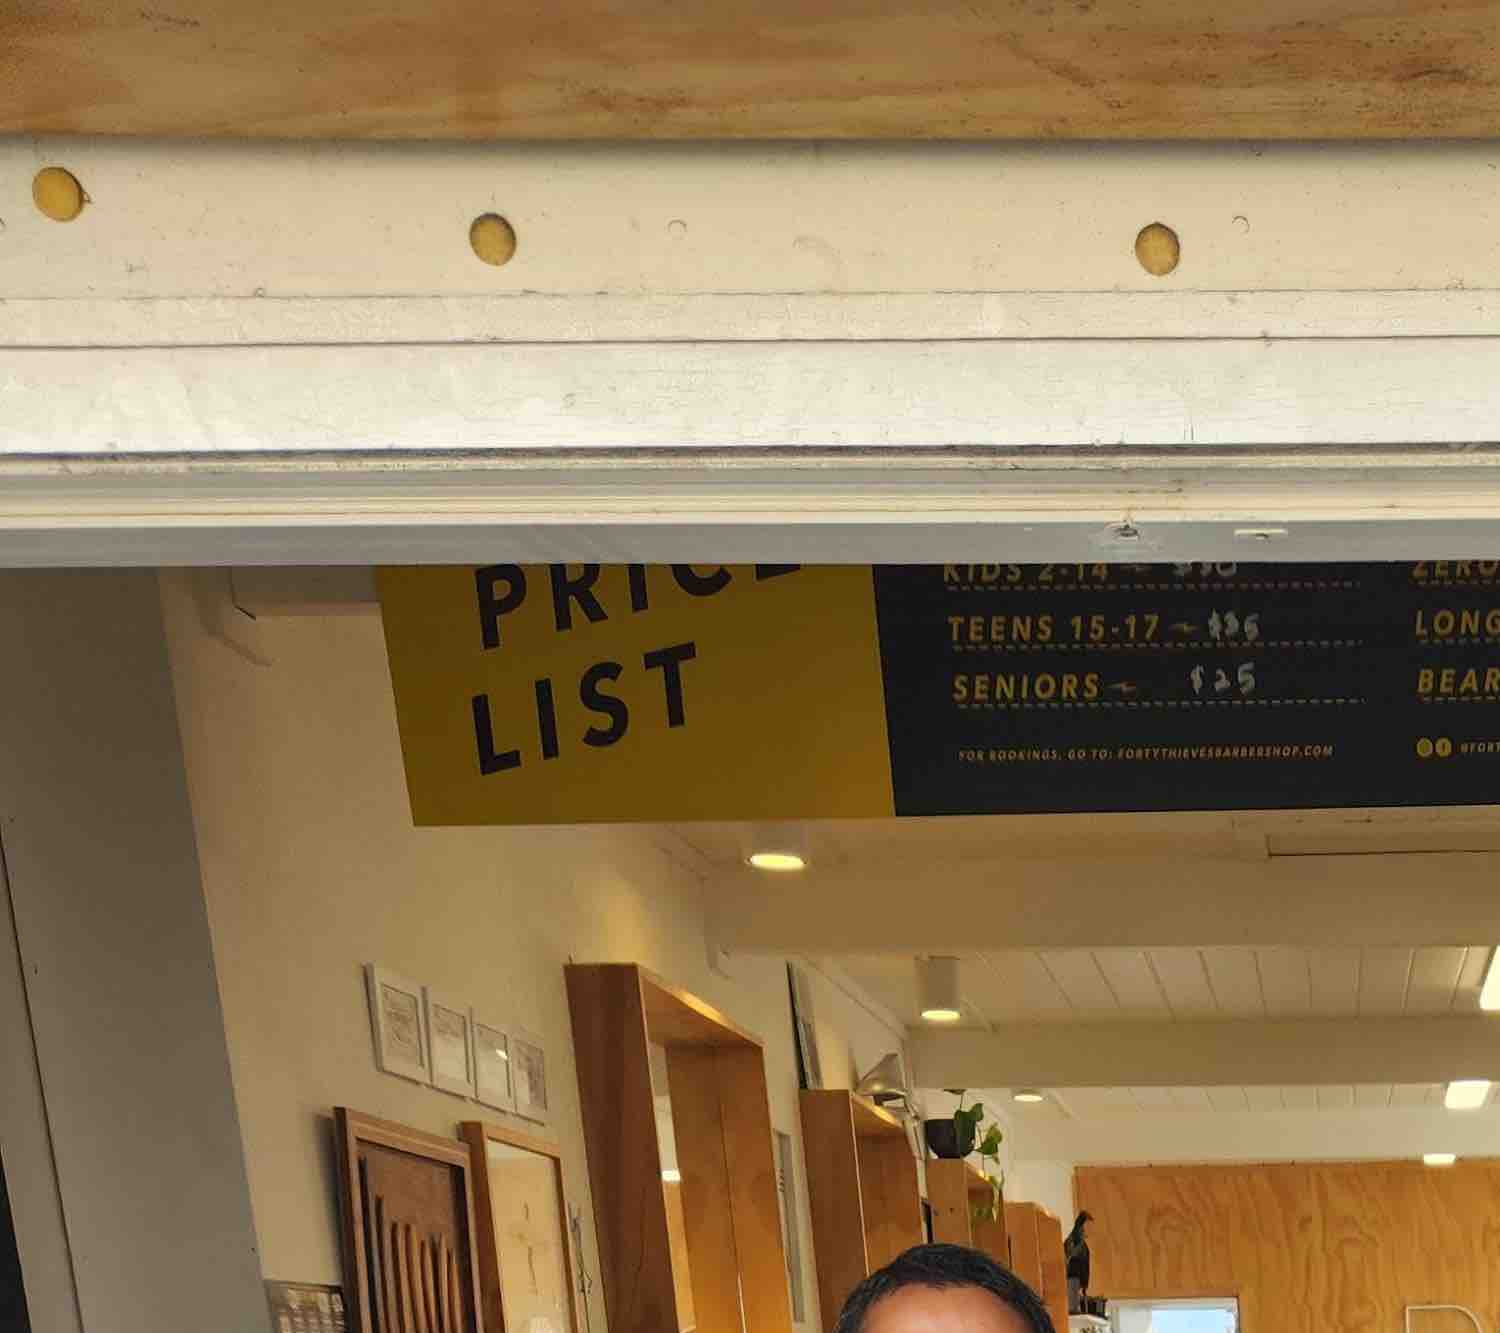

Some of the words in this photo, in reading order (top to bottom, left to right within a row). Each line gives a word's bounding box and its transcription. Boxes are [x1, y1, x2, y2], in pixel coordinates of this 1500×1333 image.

[943, 562, 1023, 583] KIDS
[474, 563, 801, 650] PRI
[948, 615, 1053, 642] TEENS
[1072, 614, 1160, 640] 15-17
[952, 672, 1100, 701] SENIORS
[471, 641, 697, 776] LIST
